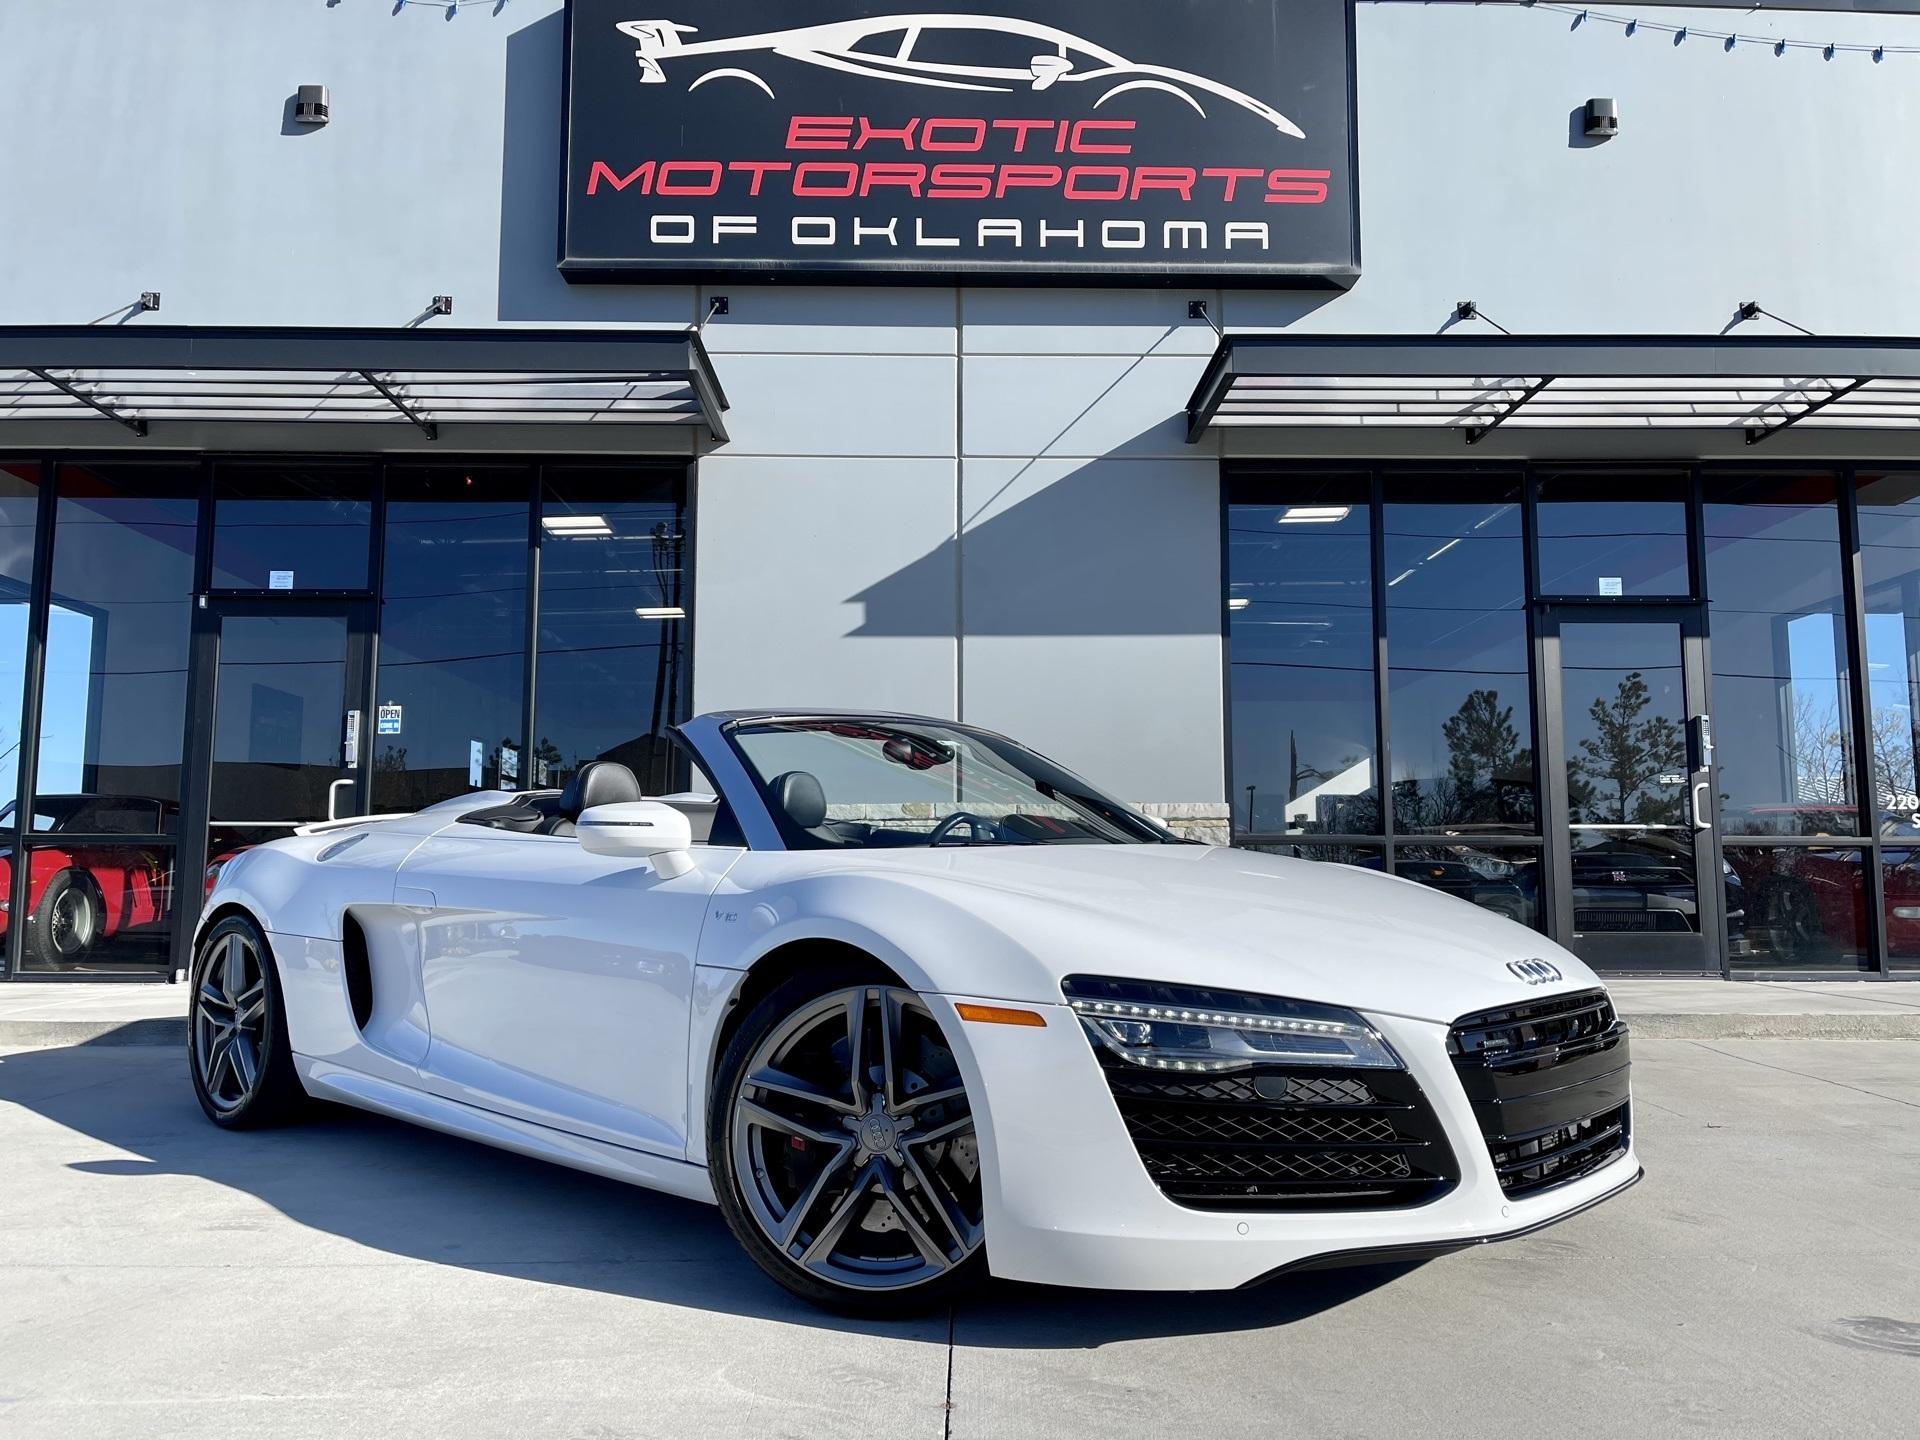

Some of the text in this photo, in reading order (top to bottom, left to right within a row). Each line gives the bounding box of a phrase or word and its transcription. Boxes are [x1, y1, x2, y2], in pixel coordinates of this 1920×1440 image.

[785, 116, 1136, 153] EXOTIC
[586, 161, 1330, 203] MOTORSPORTS
[650, 215, 1269, 250] OF OKLAHOMA
[380, 709, 400, 719] OPEN
[1886, 794, 1919, 810] 220
